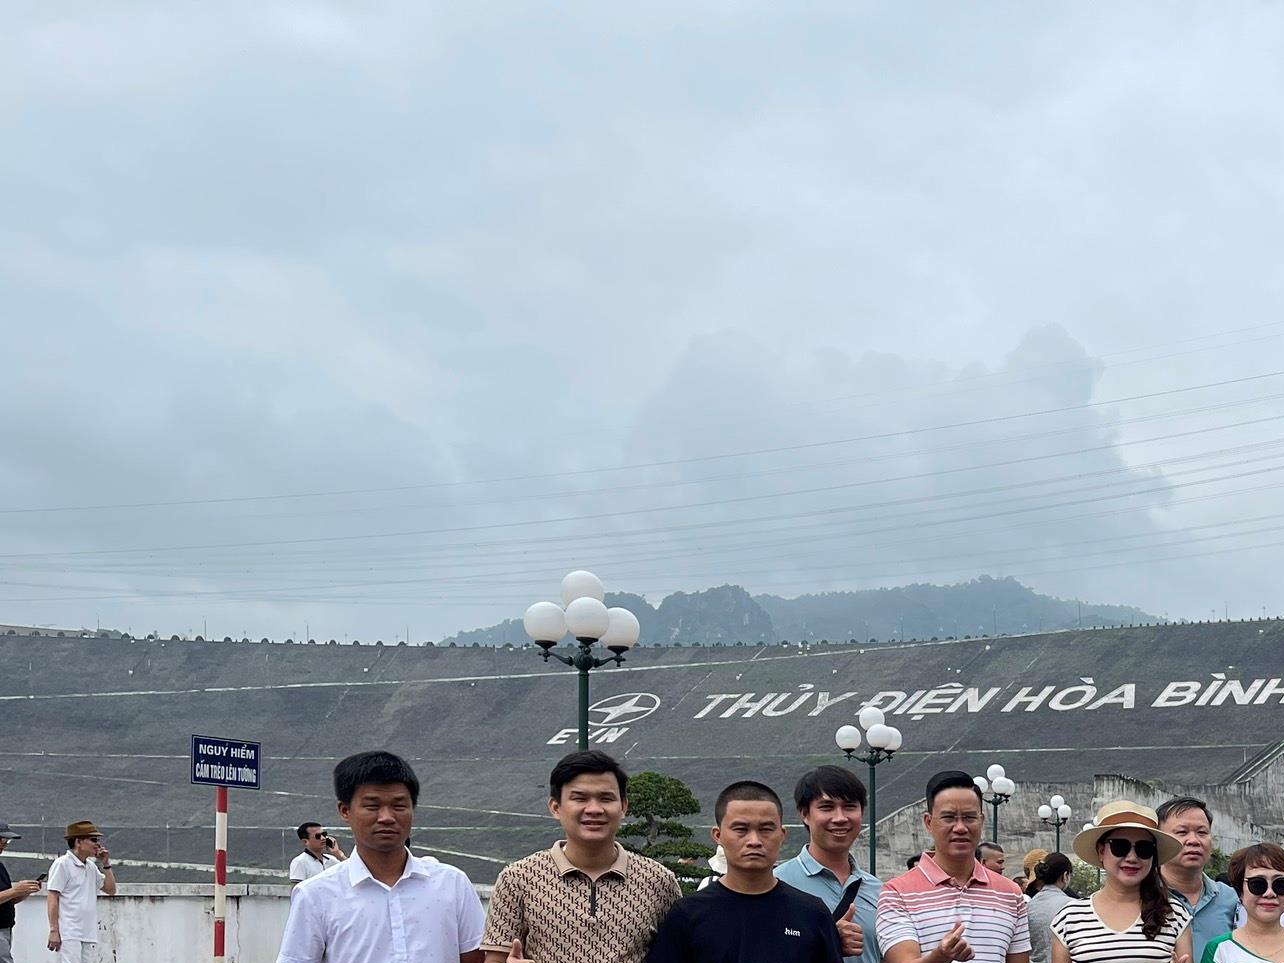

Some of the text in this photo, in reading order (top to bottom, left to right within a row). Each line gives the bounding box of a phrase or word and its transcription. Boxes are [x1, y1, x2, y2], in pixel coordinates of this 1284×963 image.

[694, 683, 858, 719] THỦY
[854, 682, 1001, 721] ĐIỆN
[1000, 677, 1136, 712] HÒA
[230, 744, 255, 760] HIỂM
[195, 759, 210, 779] CẤM
